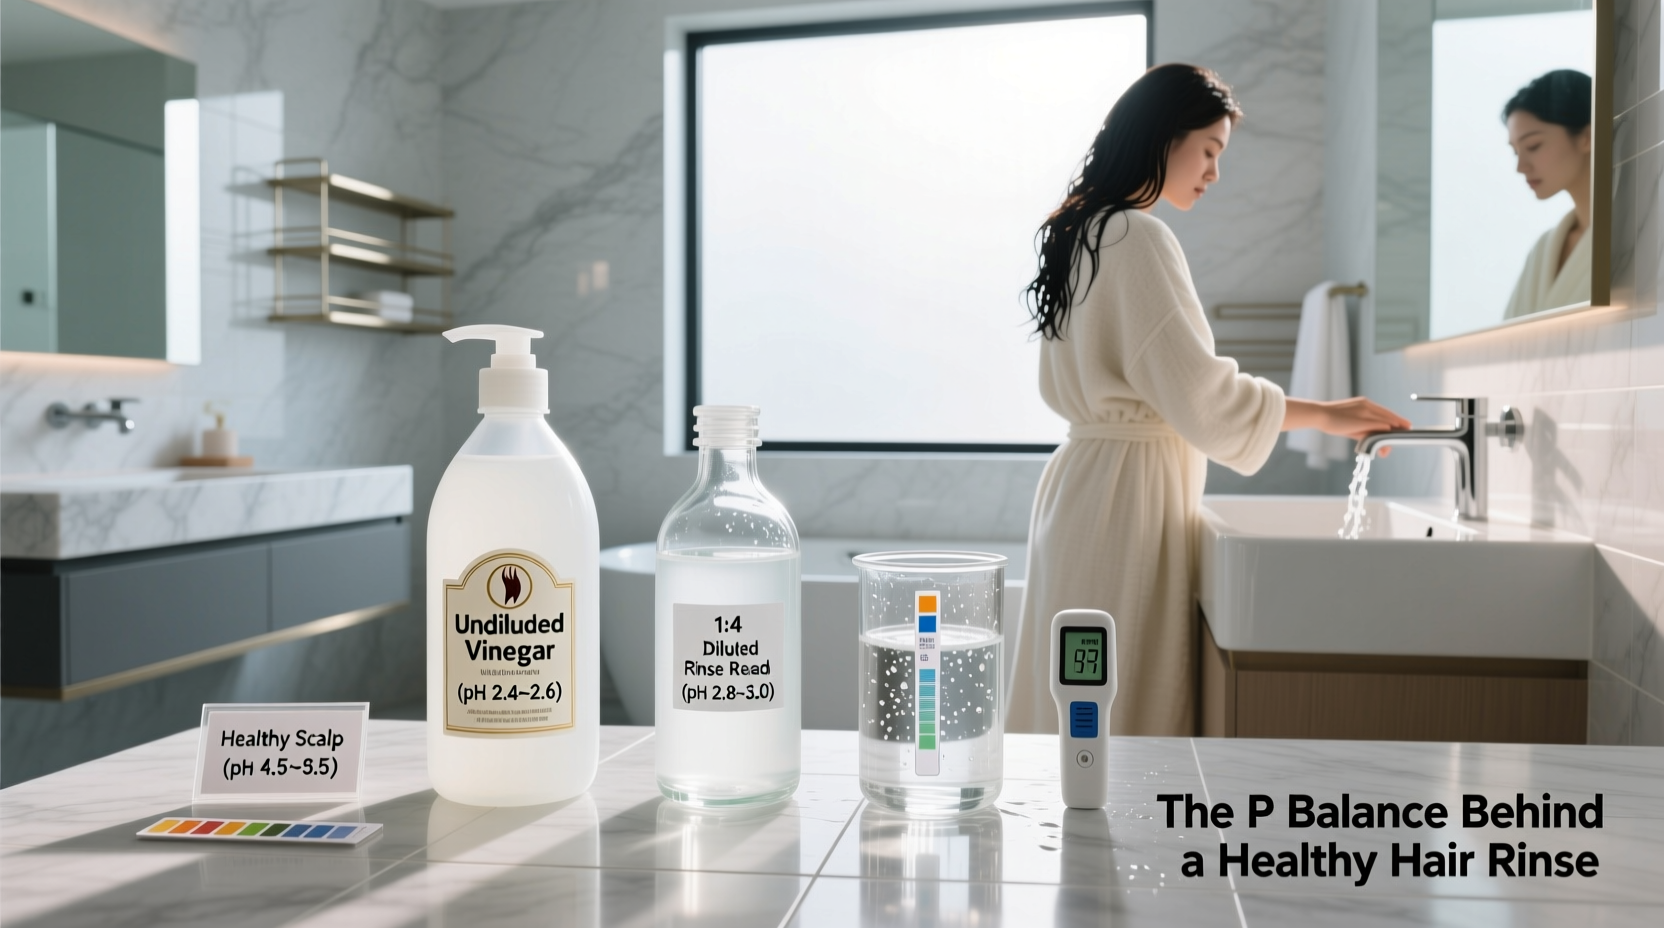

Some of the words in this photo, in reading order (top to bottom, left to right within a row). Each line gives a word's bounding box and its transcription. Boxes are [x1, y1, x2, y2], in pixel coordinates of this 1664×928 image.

[456, 613, 563, 635] Undiluded
[715, 616, 742, 633] 1:4
[465, 640, 555, 667] Vinegar
[703, 640, 758, 656] Diluted
[685, 661, 723, 676] Rinse
[458, 683, 486, 705] (pH
[682, 684, 707, 703] (pH
[222, 729, 290, 751] Healthy
[296, 729, 343, 751] Scalp
[224, 758, 253, 780] (pH
